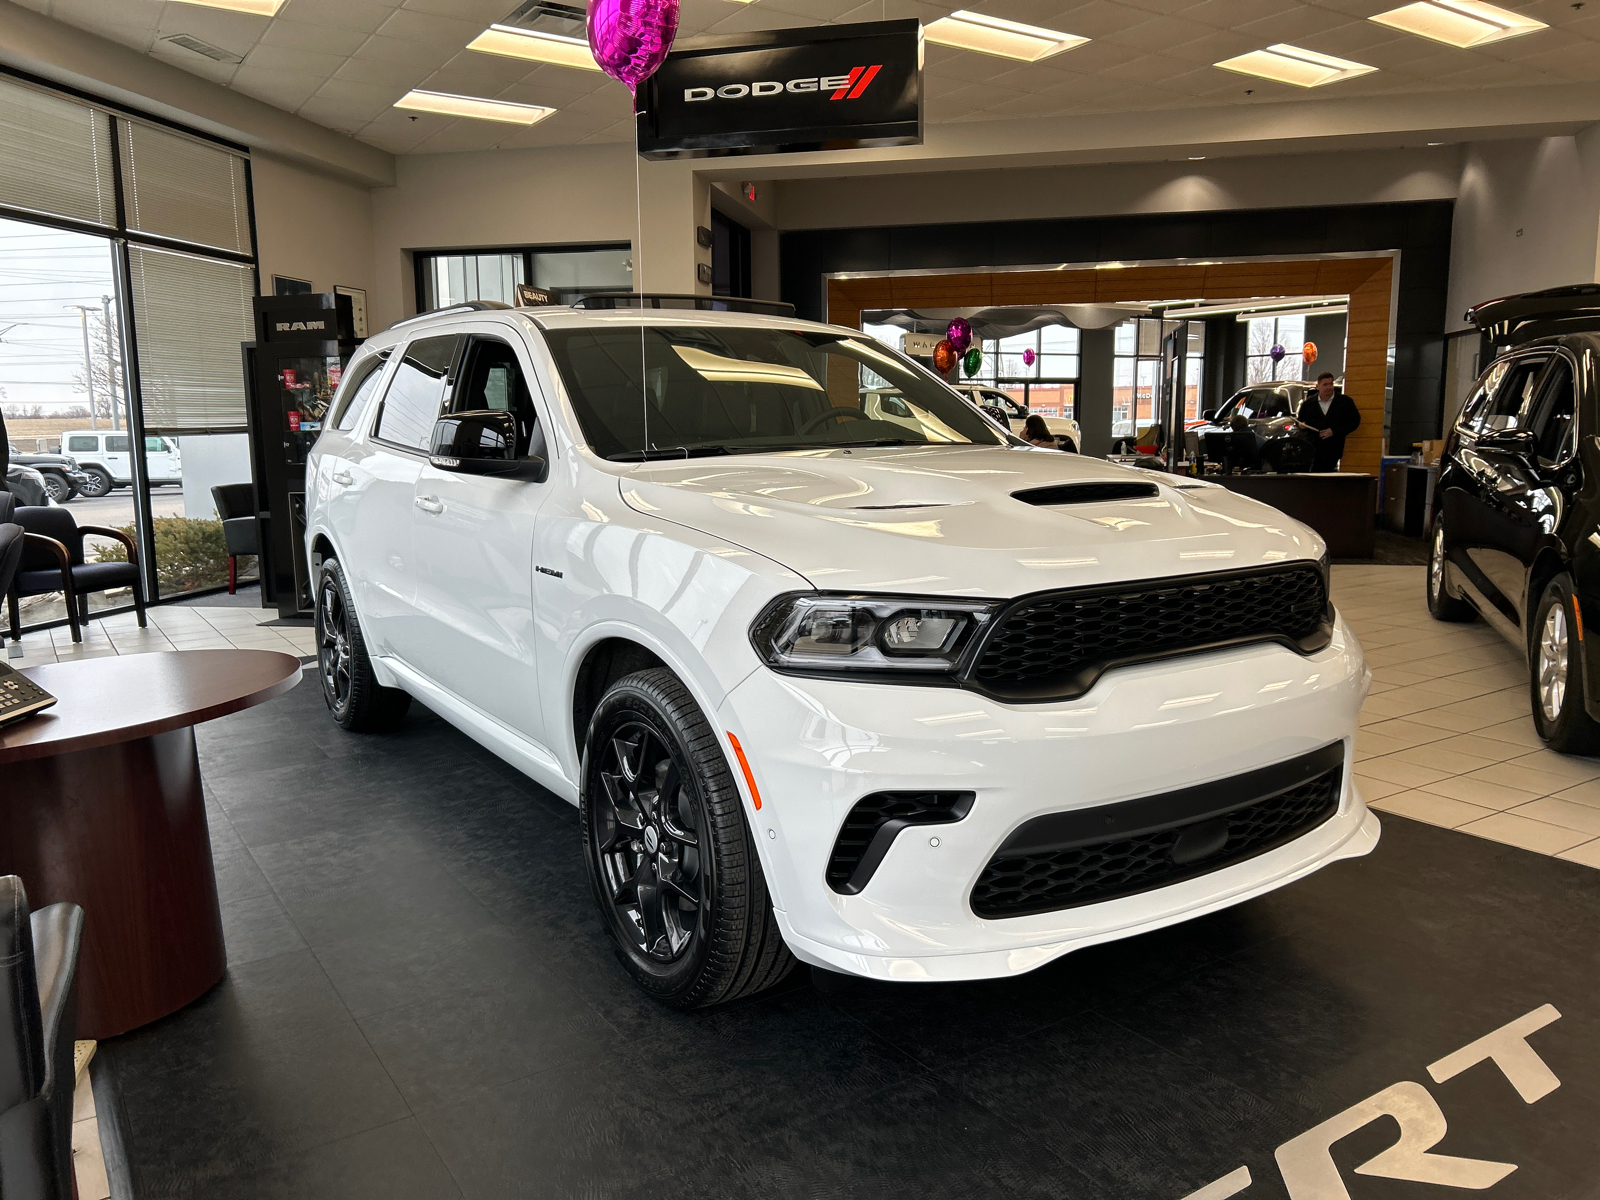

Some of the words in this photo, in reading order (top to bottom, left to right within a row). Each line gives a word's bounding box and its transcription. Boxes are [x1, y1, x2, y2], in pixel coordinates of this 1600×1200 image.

[684, 74, 851, 102] DODGE
[523, 290, 548, 302] BEAUTY
[276, 321, 325, 331] RAM
[1178, 1003, 1562, 1200] RT
